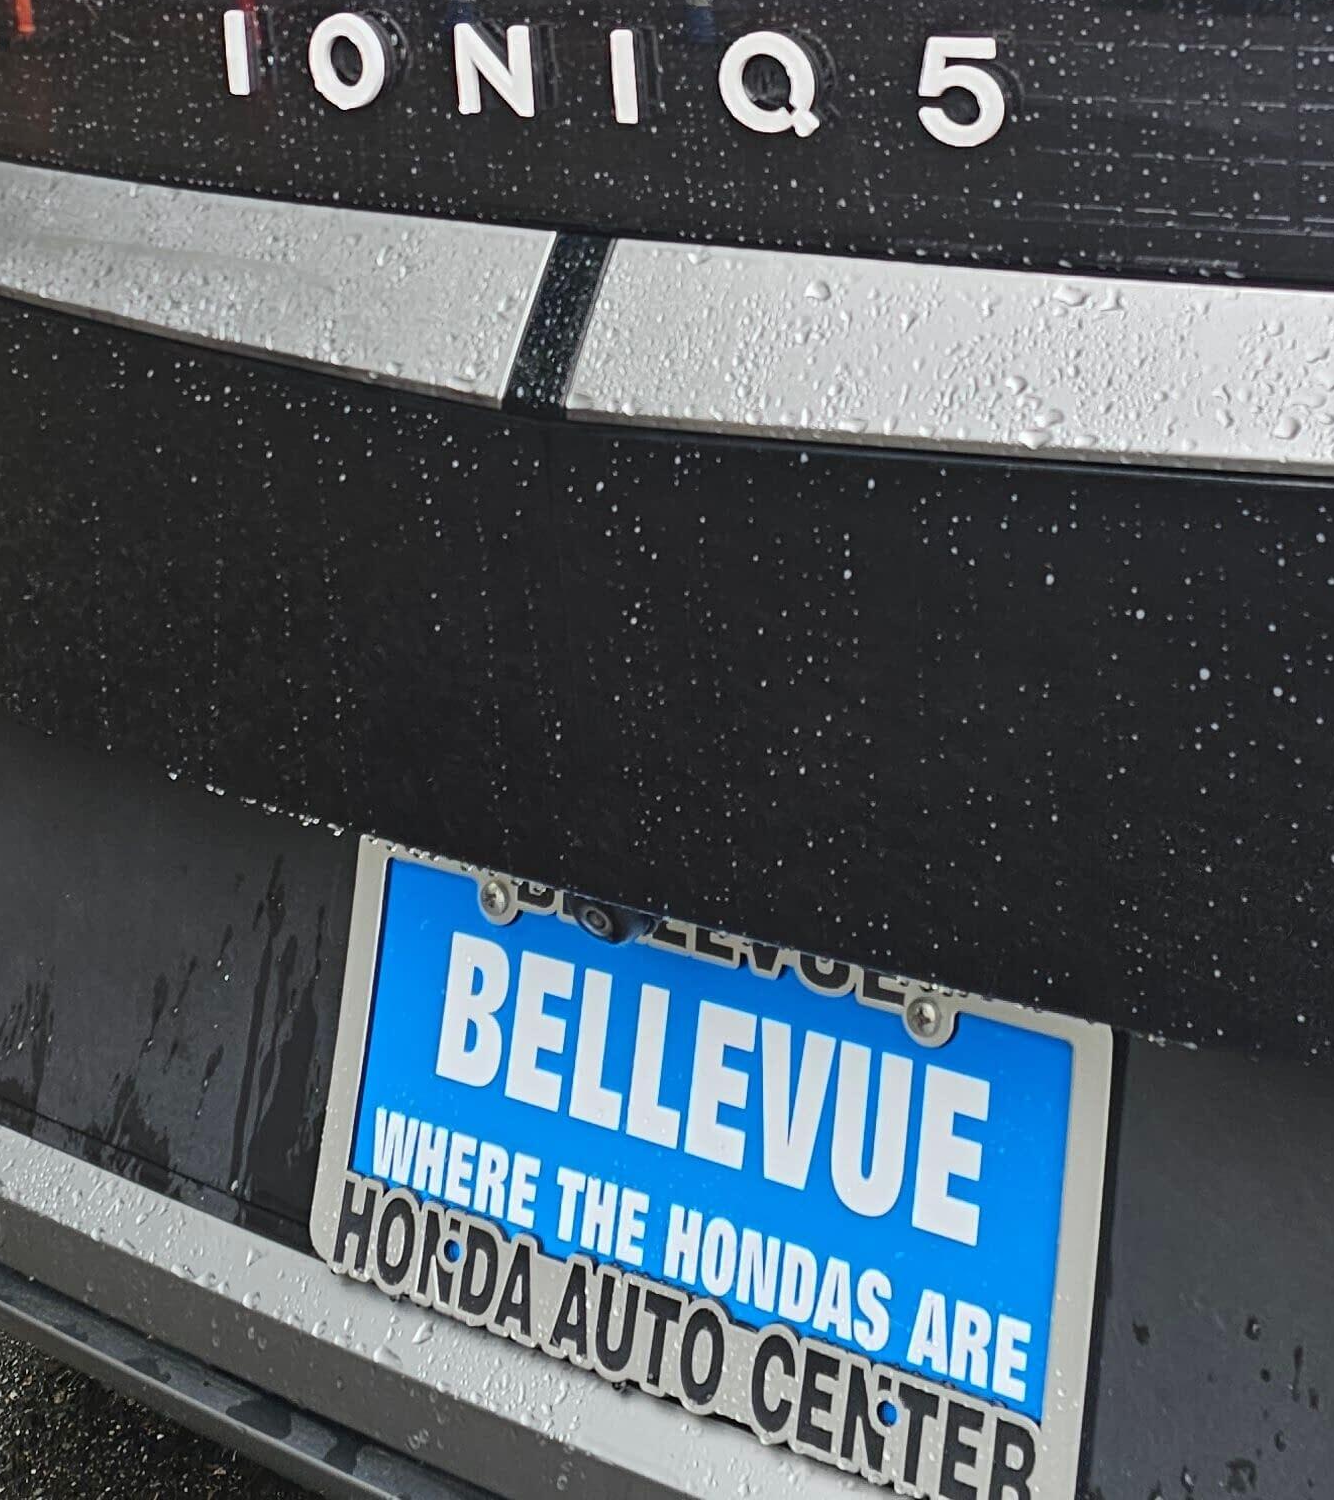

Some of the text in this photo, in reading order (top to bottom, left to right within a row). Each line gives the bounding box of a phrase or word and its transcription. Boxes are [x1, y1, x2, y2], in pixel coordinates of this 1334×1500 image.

[222, 8, 1006, 147] IONIQ 5
[434, 930, 991, 1247] BELLEVUE
[332, 1178, 1037, 1500] HONDA AUTO CENTER
[372, 1106, 1032, 1403] WHERE THE HONDAS ARE
